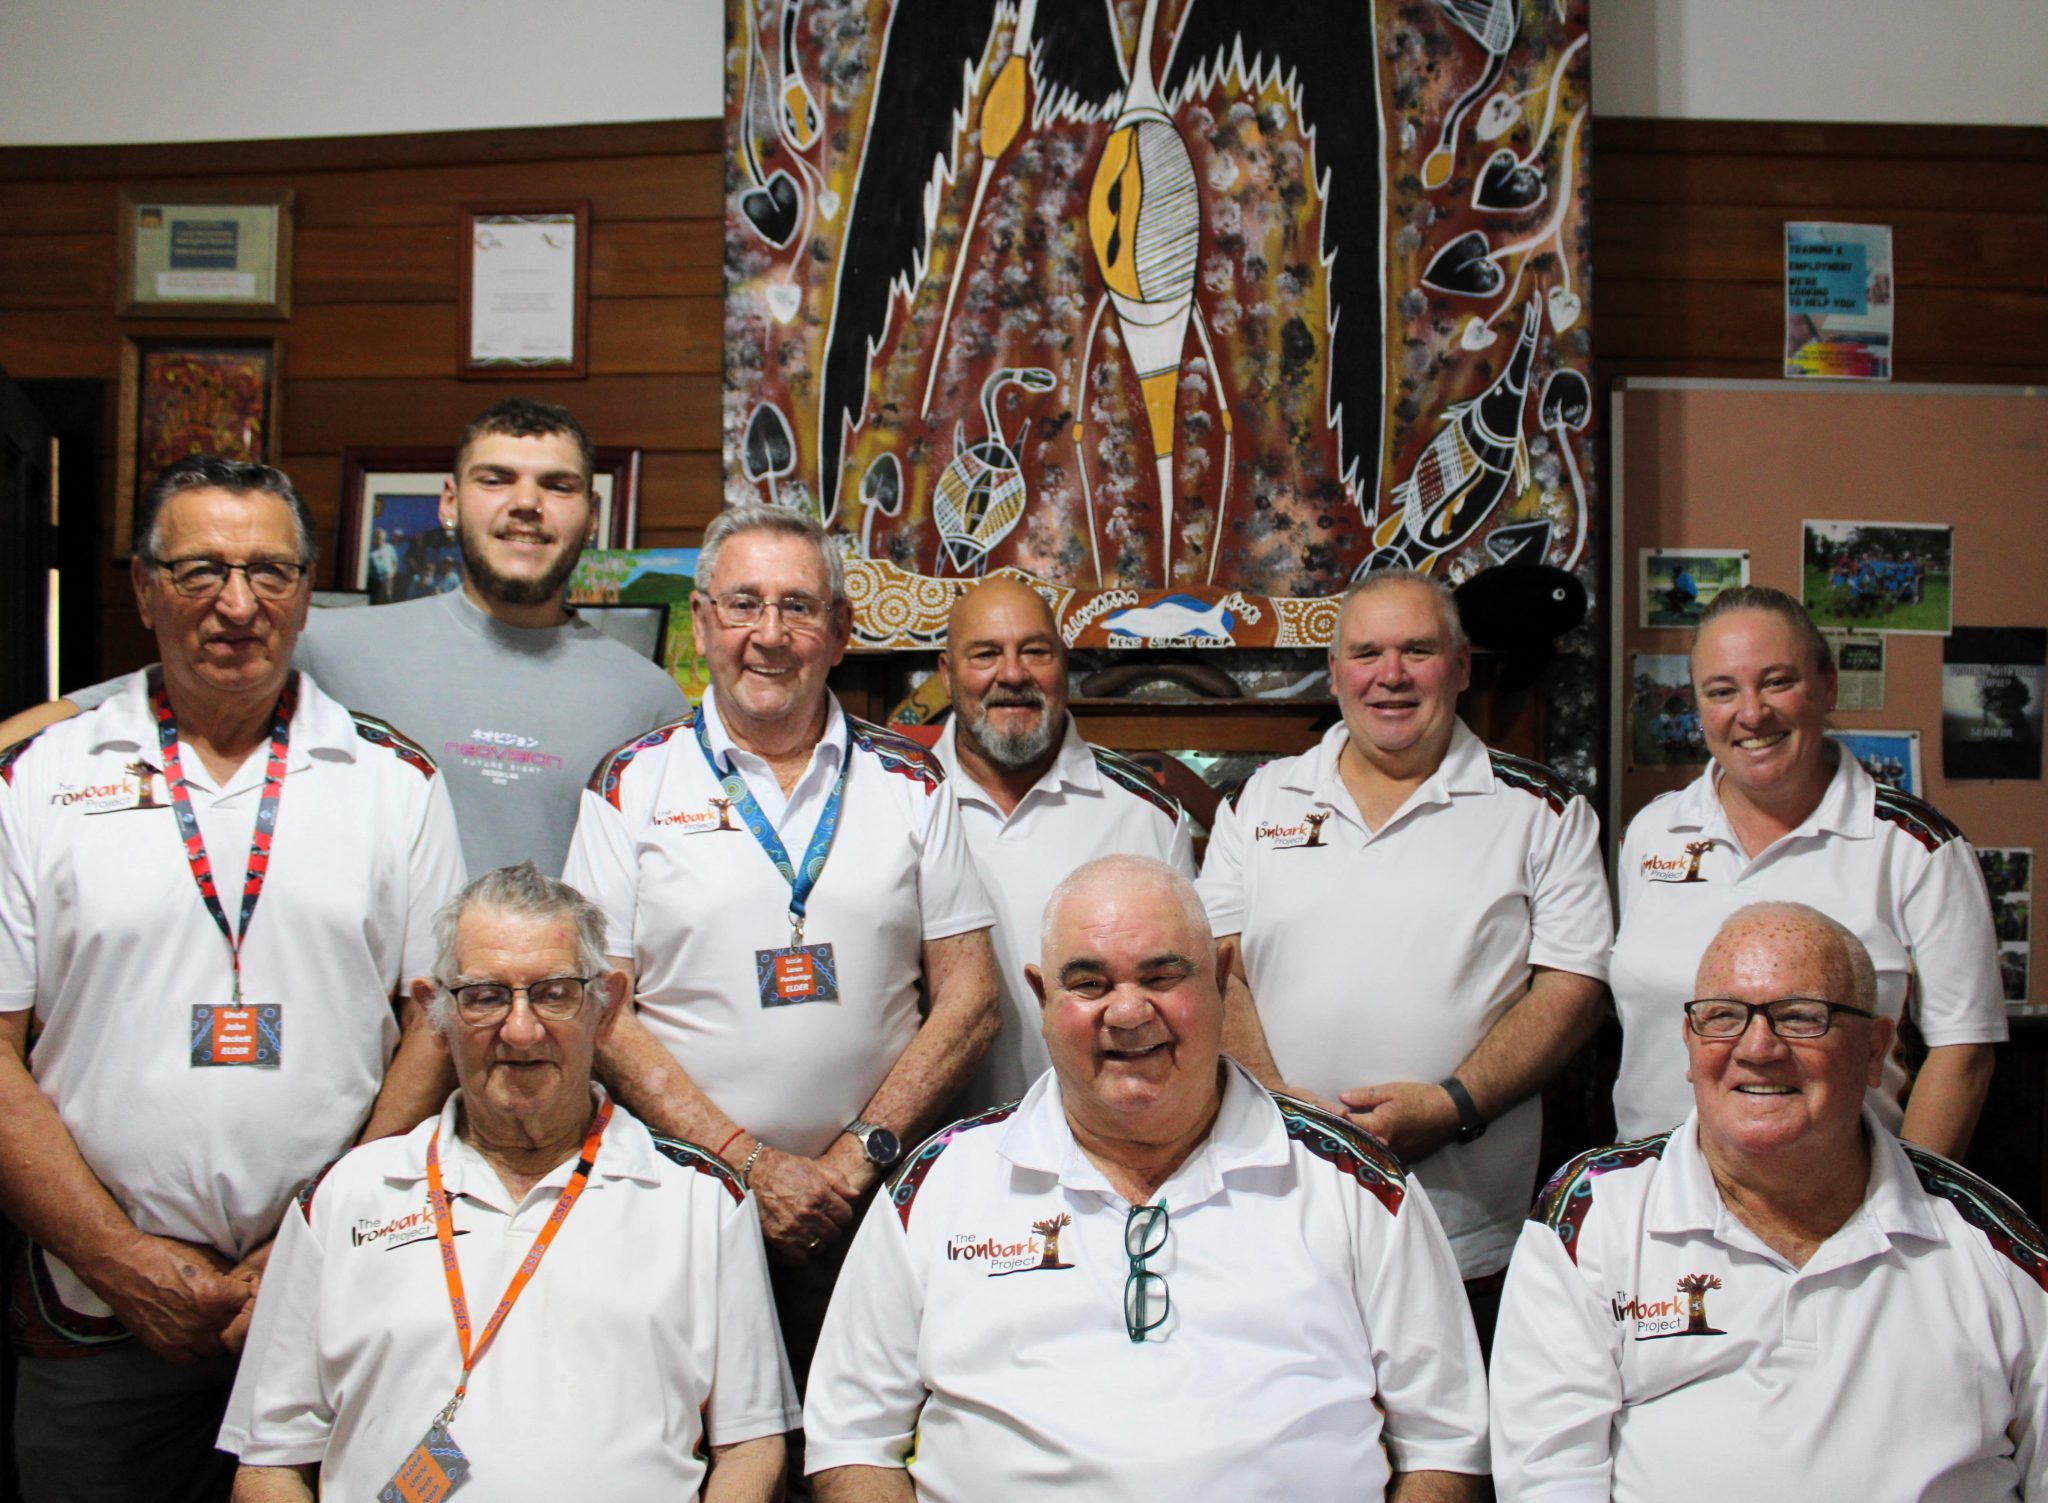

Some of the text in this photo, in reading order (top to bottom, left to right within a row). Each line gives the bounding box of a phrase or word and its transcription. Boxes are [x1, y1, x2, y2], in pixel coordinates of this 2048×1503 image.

[1789, 262, 1853, 272] EMPLOYMENT
[1063, 590, 1262, 647] ILLAWARRA KOORI
[785, 983, 809, 993] ELDER
[358, 1218, 381, 1229] The
[388, 1226, 430, 1244] Project
[955, 1234, 976, 1244] The
[947, 1237, 1040, 1260] Ironbark
[991, 1256, 1035, 1269] Project
[1637, 1317, 1681, 1333] Project
